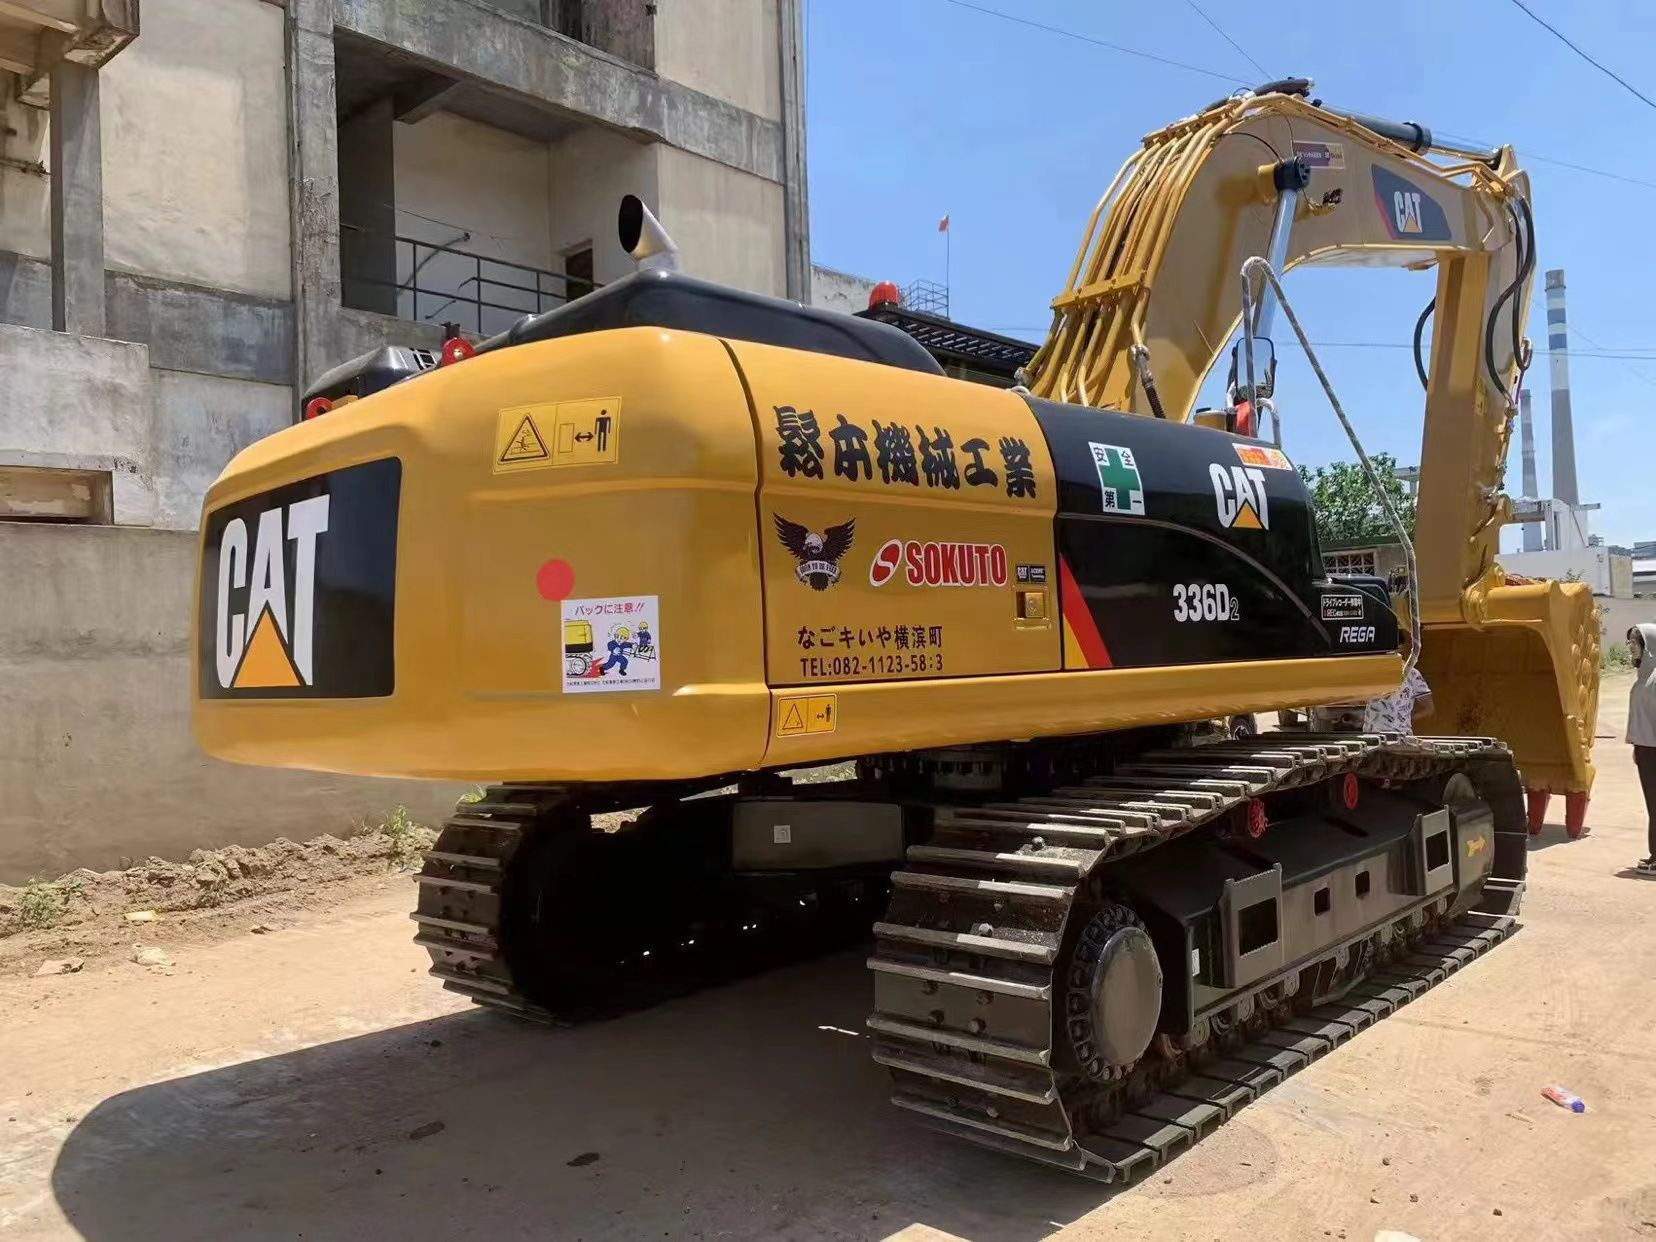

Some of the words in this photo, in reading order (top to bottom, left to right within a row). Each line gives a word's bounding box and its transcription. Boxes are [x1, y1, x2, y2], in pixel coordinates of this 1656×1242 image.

[1393, 191, 1423, 233] CAT
[1209, 463, 1270, 530] CAT
[905, 541, 1008, 587] SOKUTO
[216, 493, 331, 689] CAT
[1339, 626, 1376, 643] REGA
